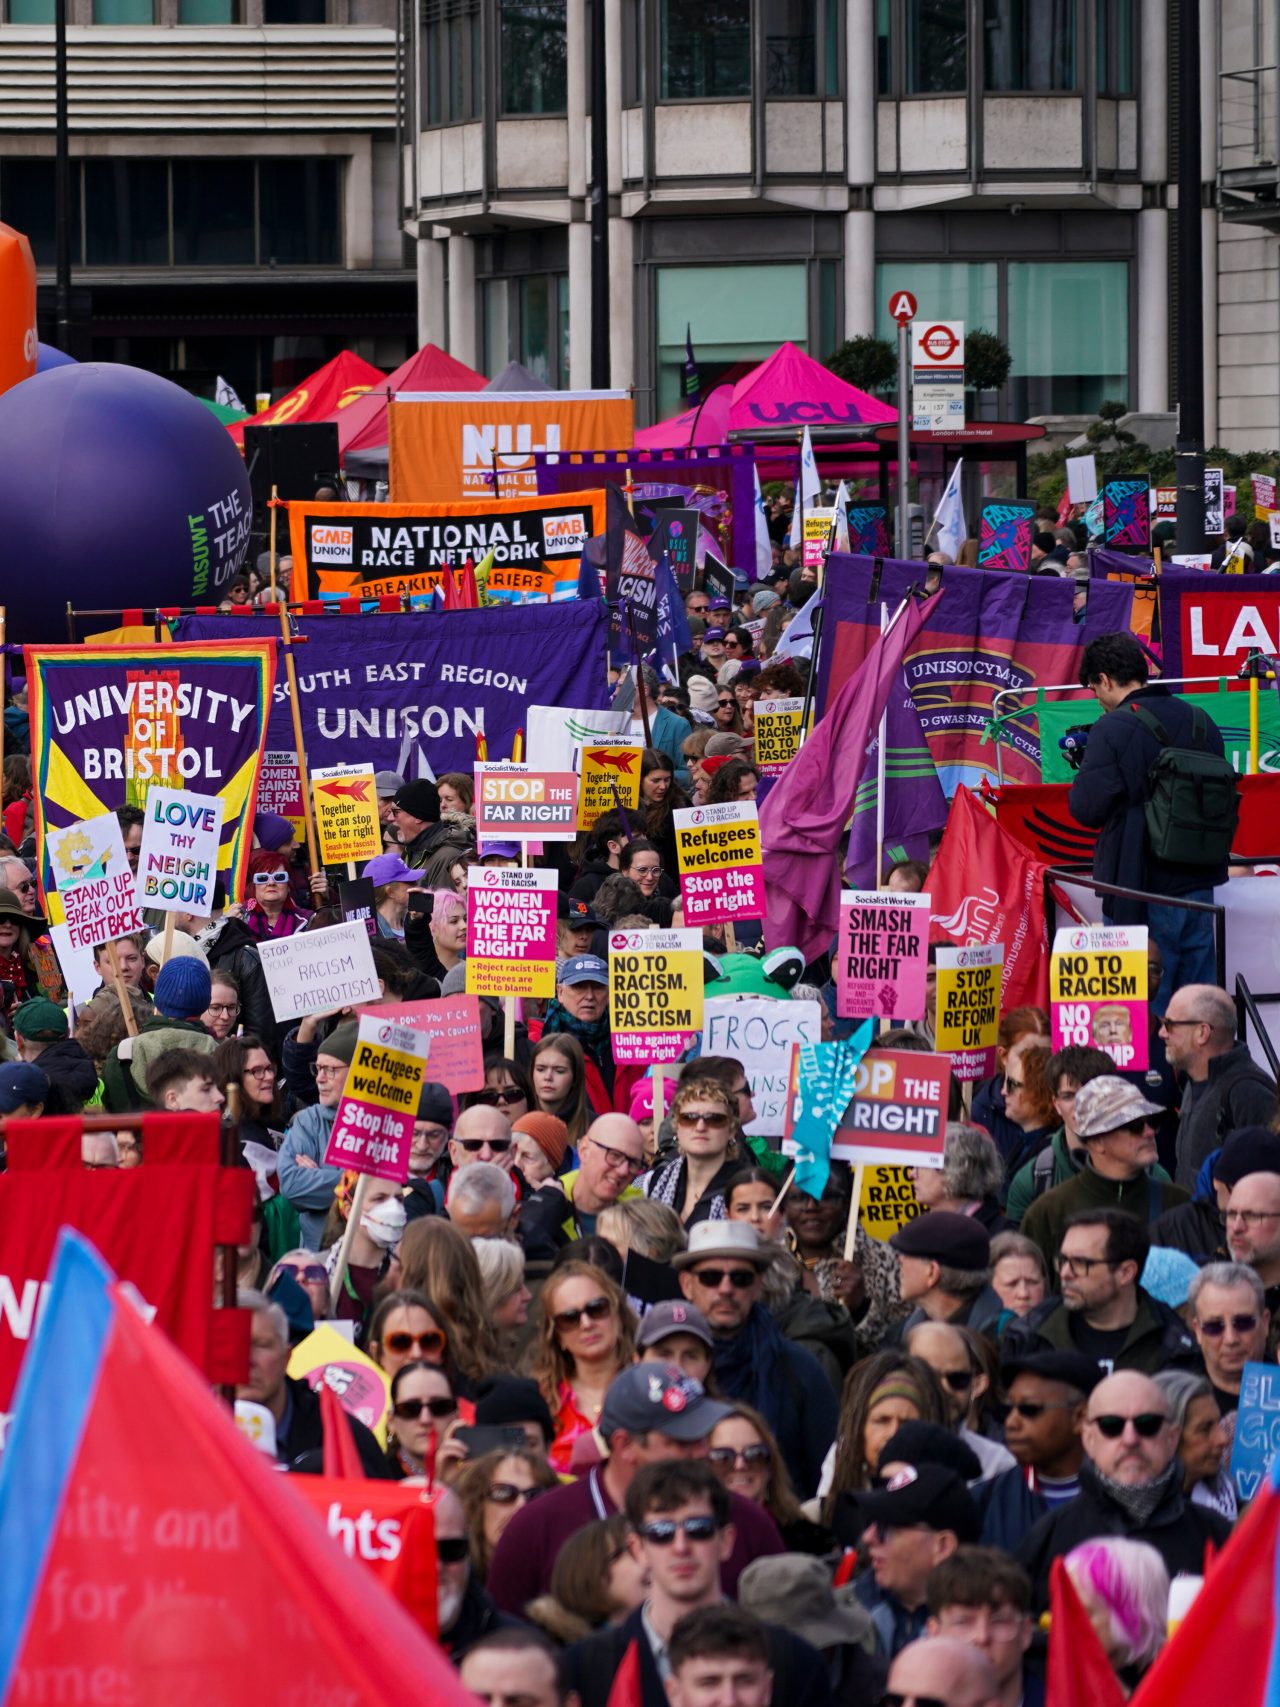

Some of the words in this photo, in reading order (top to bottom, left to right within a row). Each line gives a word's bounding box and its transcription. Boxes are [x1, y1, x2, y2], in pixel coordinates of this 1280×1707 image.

[894, 295, 913, 317] A
[748, 402, 864, 422] UCU
[914, 418, 930, 426] N137
[207, 488, 243, 529] THE
[312, 529, 353, 544] GMB
[371, 521, 528, 549] NATIONAL
[544, 516, 583, 536] GMB
[312, 545, 351, 556] UNION
[546, 536, 584, 547] UNION
[188, 514, 210, 597] NASUWT
[361, 548, 415, 566] RACE
[366, 662, 426, 682] EAST
[441, 664, 528, 695] REGION
[973, 661, 1024, 689] CYMU
[53, 681, 256, 735] UNIVERSITY
[134, 718, 166, 743] OF
[318, 706, 485, 740] UNISON
[84, 746, 222, 780] BRISTOL
[484, 780, 544, 802] STOP
[550, 788, 572, 800] THE
[154, 799, 216, 833] LOVE
[320, 802, 356, 817] Together
[484, 806, 516, 822] FAR
[520, 805, 572, 821] RIGHT
[323, 820, 333, 828] we
[336, 818, 350, 826] can
[352, 814, 372, 826] stop
[170, 832, 196, 849] THY
[324, 830, 336, 840] the
[339, 828, 350, 838] far
[353, 826, 374, 838] right
[681, 826, 756, 850] Refugees
[148, 852, 210, 882] NEIGH
[683, 846, 754, 868] welcome
[64, 882, 111, 910] STAND
[114, 872, 132, 894] UP
[144, 875, 208, 905] BOUR
[685, 874, 723, 895] Stop
[726, 872, 754, 888] the
[66, 898, 113, 926] SPEAK
[114, 888, 138, 912] OUT
[474, 892, 542, 909] WOMEN
[686, 894, 712, 914] far
[715, 890, 755, 912] right
[69, 920, 110, 950] FIGHT
[106, 906, 145, 938] BACK
[473, 908, 550, 926] AGAINST
[849, 910, 912, 932] SMASH
[474, 924, 508, 942] THE
[512, 926, 546, 942] FAR
[262, 944, 290, 960] STOP
[294, 930, 356, 954] DISGUISING
[472, 940, 528, 958] RIGHT
[848, 933, 882, 956] THE
[886, 934, 920, 956] FAR
[298, 956, 354, 981] RACISM
[614, 956, 639, 973] NO
[642, 955, 668, 972] TO
[847, 956, 902, 980] RIGHT
[1059, 956, 1088, 976] NO
[1094, 954, 1122, 974] TO
[614, 974, 688, 992] RACISM,
[956, 968, 992, 988] STOP
[1060, 976, 1136, 997] RACISM
[294, 978, 376, 1010] PATRIOTISM
[614, 992, 640, 1010] NO
[644, 992, 670, 1008] TO
[948, 988, 995, 1008] RACIST
[615, 1010, 692, 1027] FASCISM
[944, 1007, 995, 1028] REFORM
[1060, 1004, 1090, 1026] NO
[616, 1034, 640, 1047] Unite
[642, 1034, 682, 1048] against
[708, 1015, 809, 1051] FROGS
[962, 1028, 981, 1046] UK
[1060, 1026, 1090, 1046] TO
[616, 1047, 632, 1058] the
[634, 1047, 650, 1058] far
[652, 1046, 676, 1060] right
